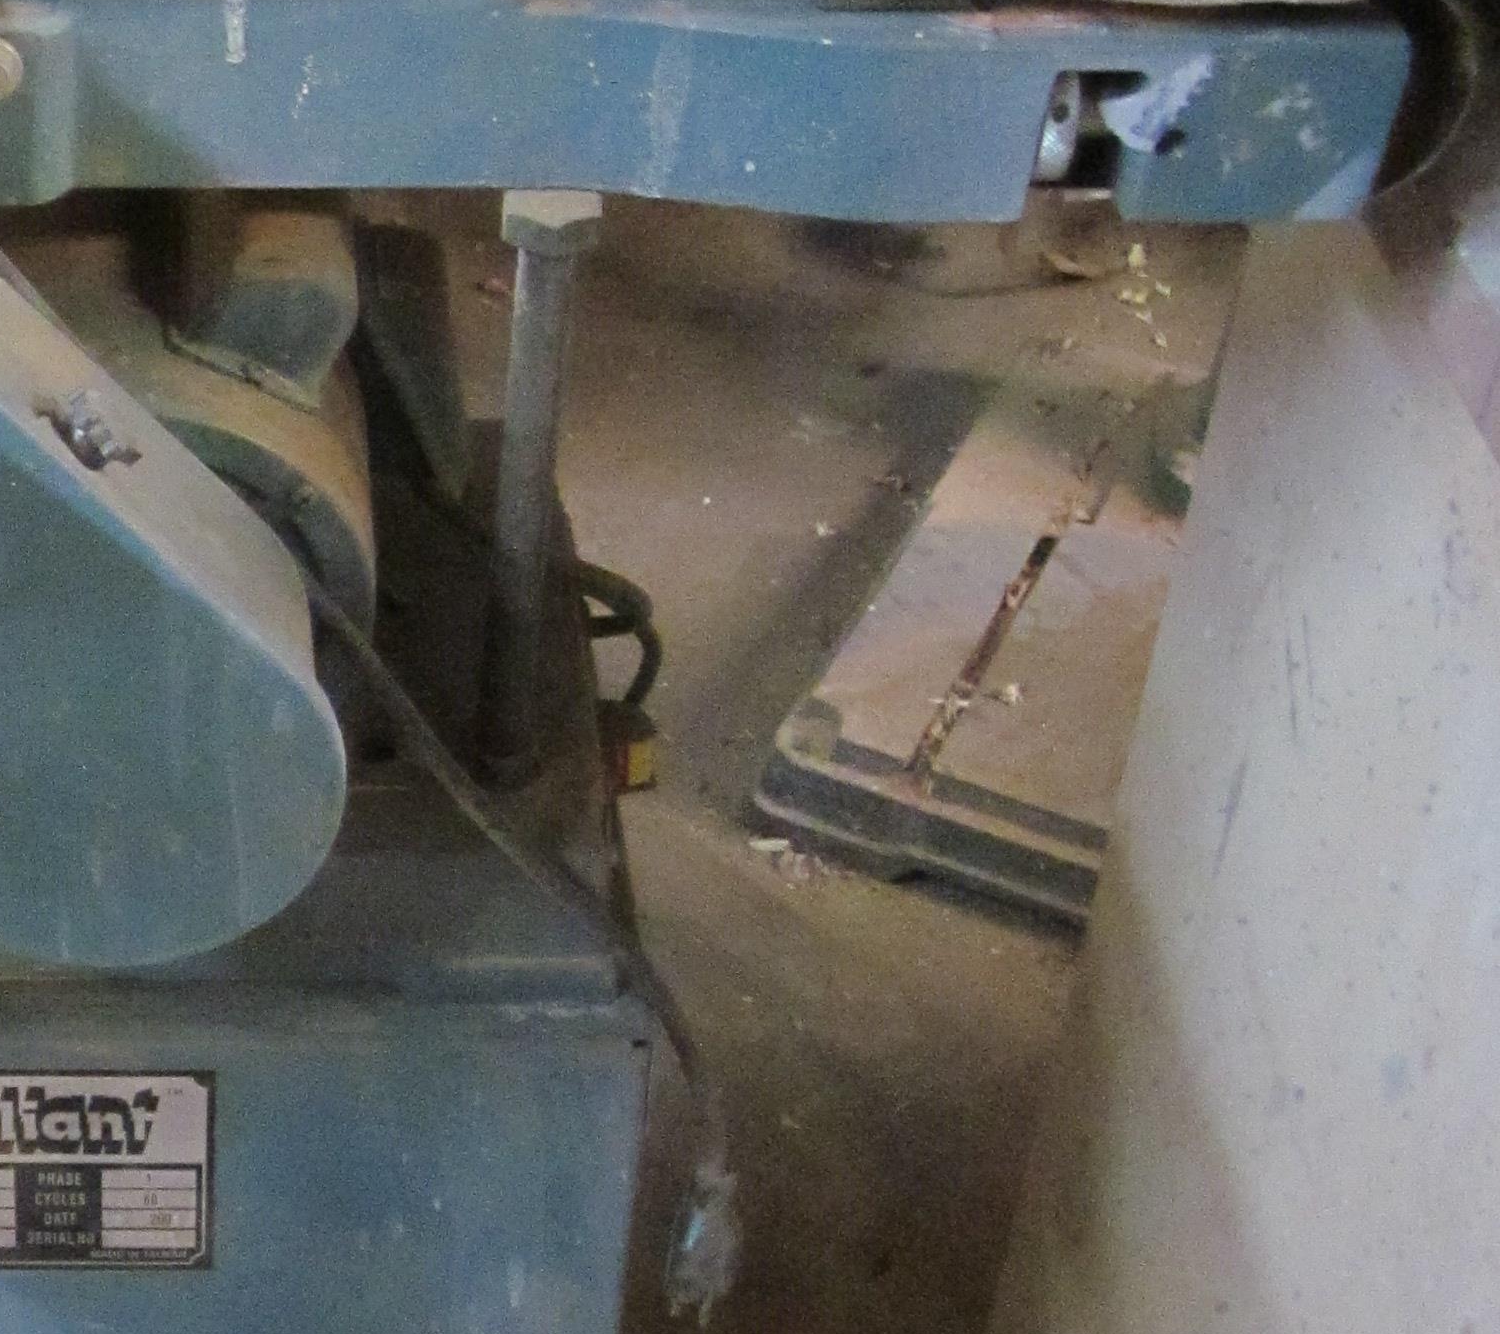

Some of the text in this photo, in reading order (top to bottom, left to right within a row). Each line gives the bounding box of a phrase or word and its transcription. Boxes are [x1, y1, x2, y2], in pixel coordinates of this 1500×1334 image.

[37, 1172, 82, 1186] PHASE
[34, 1192, 86, 1206] CYCLES
[43, 1212, 77, 1226] DATE
[26, 1231, 75, 1245] SERIAL
